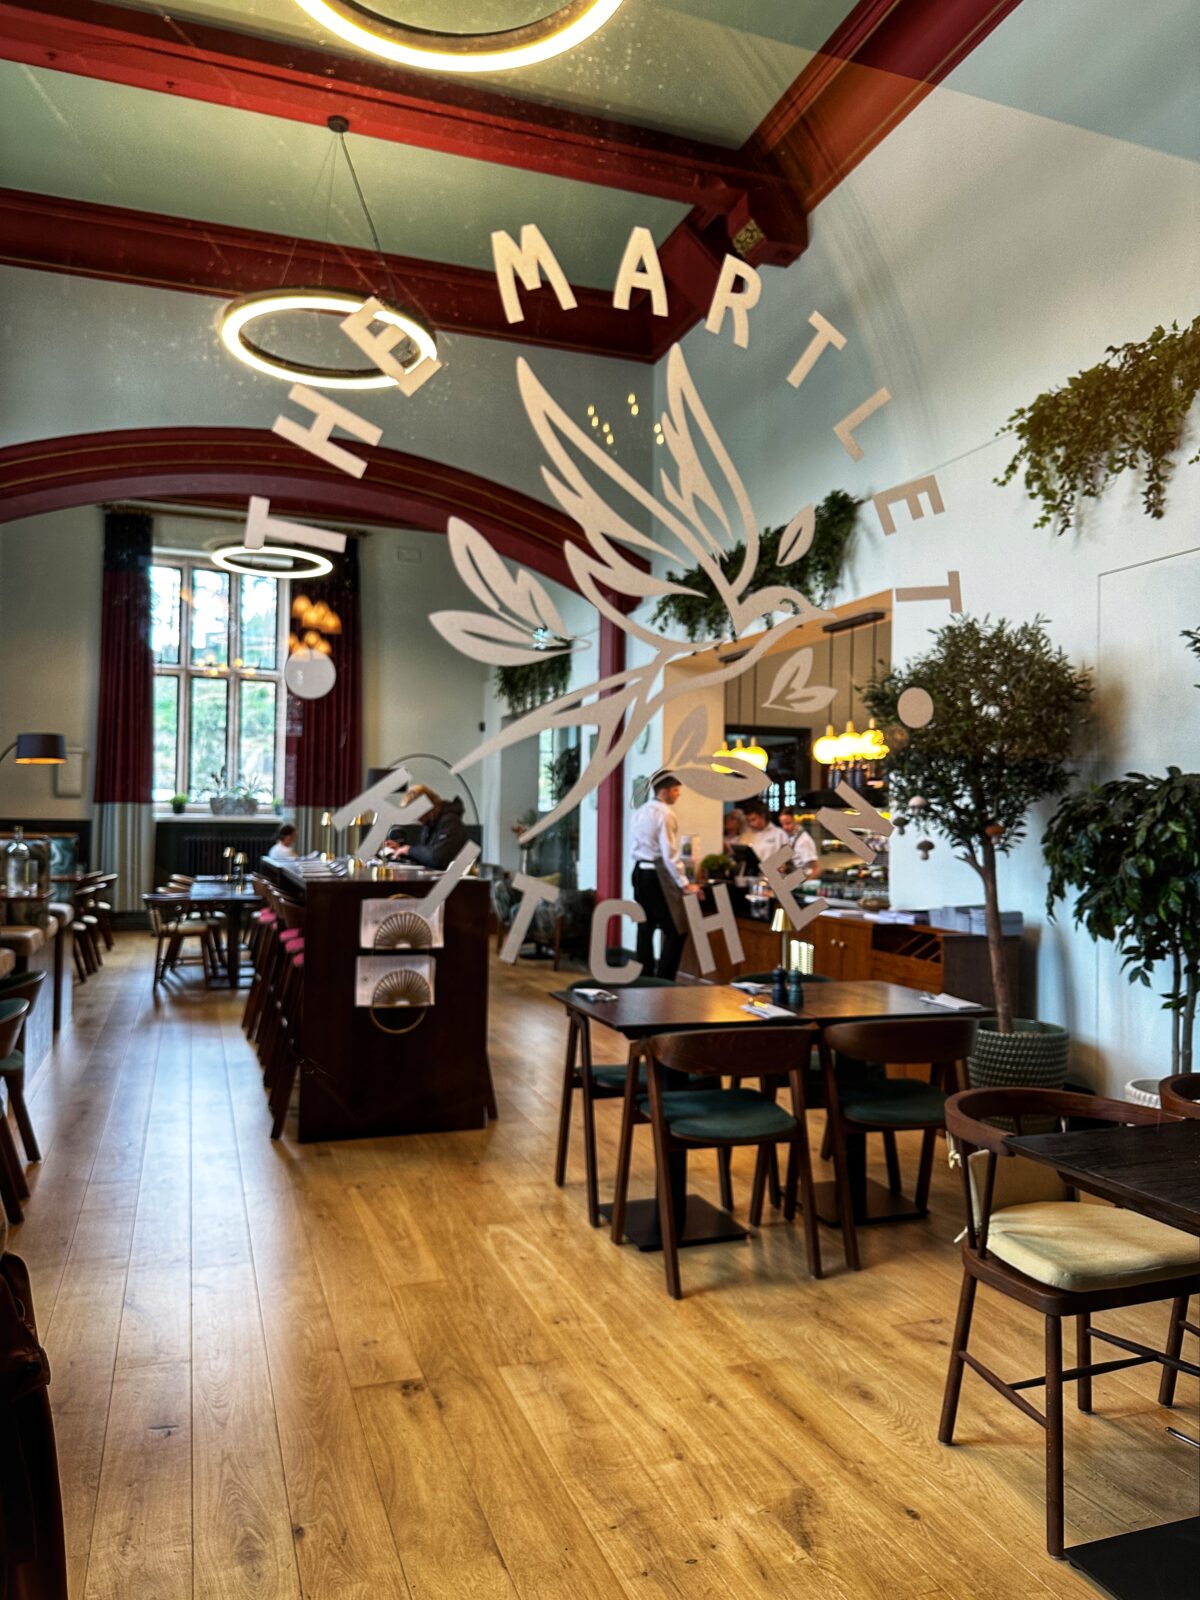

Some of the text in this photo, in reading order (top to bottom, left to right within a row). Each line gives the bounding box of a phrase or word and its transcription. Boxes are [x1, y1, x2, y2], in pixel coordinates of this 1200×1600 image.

[243, 224, 963, 614] THE MARTLET
[333, 767, 894, 984] KITCHEN
